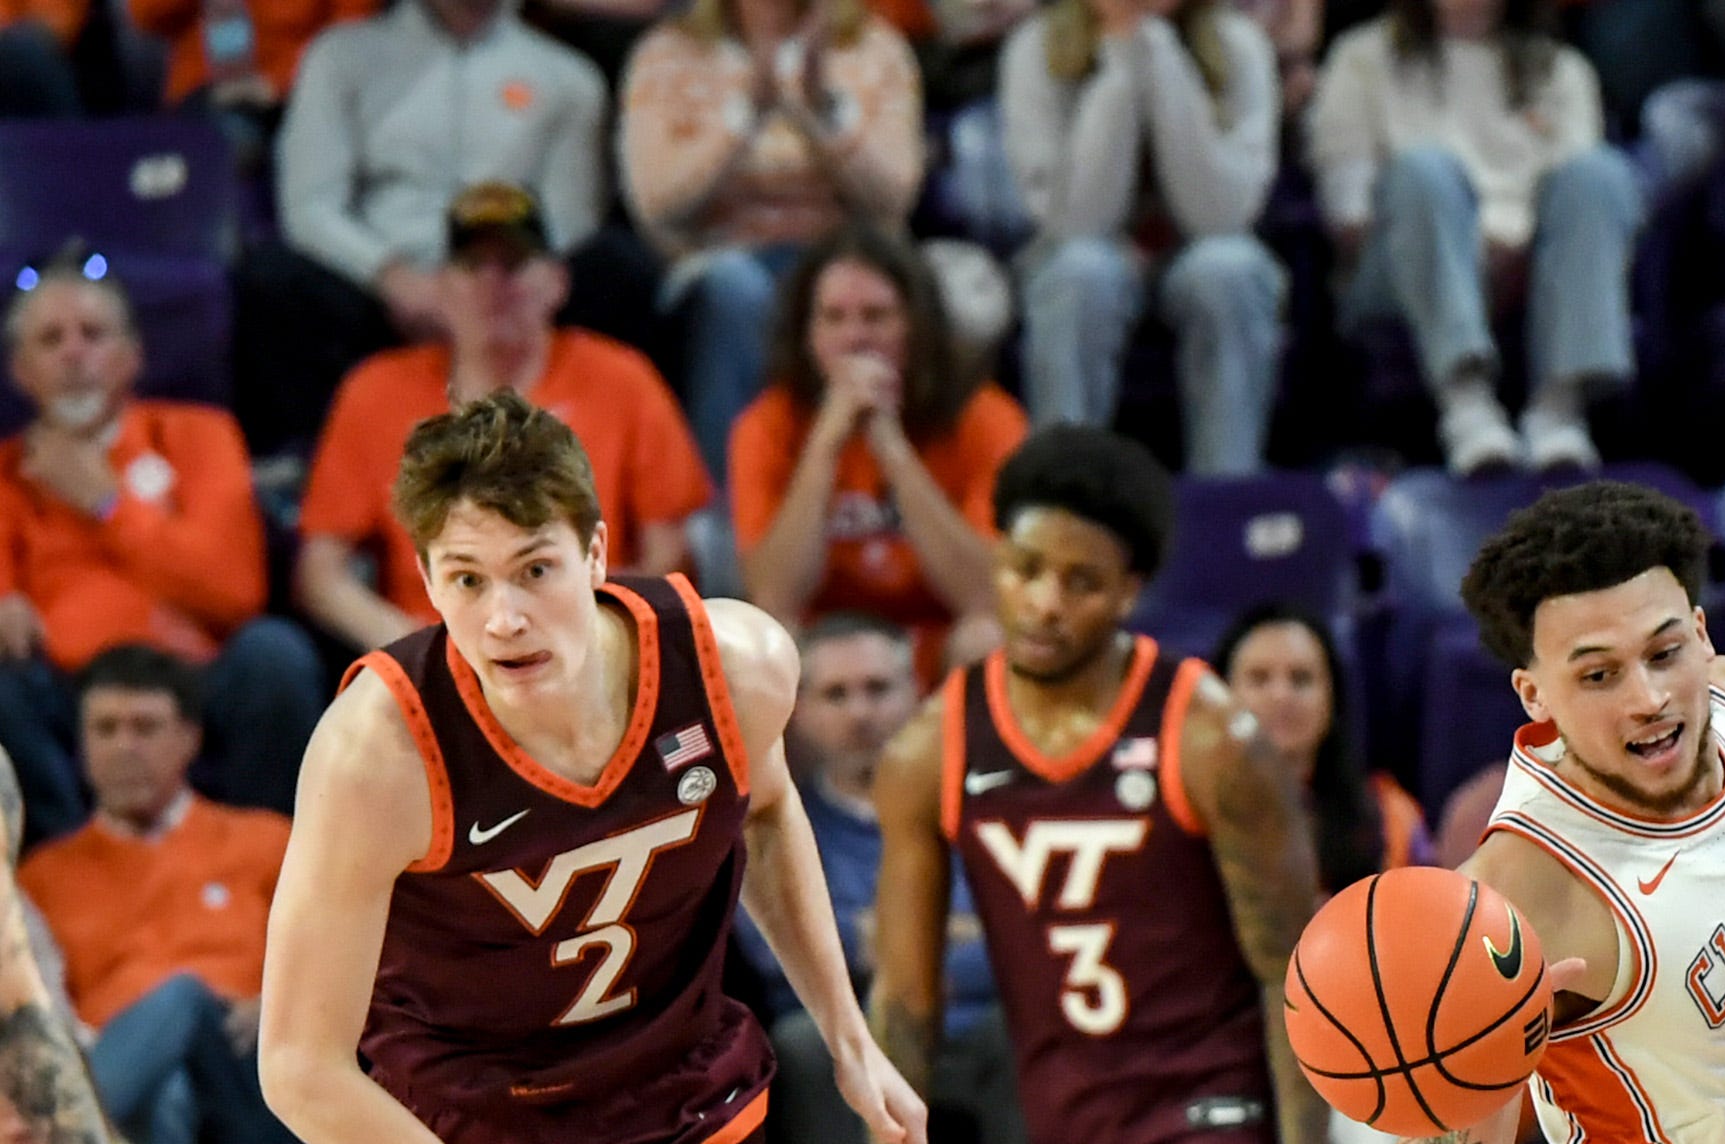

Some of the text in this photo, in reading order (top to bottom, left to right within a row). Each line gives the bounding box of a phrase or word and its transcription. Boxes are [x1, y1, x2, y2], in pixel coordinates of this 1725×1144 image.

[471, 801, 706, 937] VT
[974, 817, 1152, 912] VT
[550, 921, 638, 1026] 2
[1048, 920, 1130, 1038] 3
